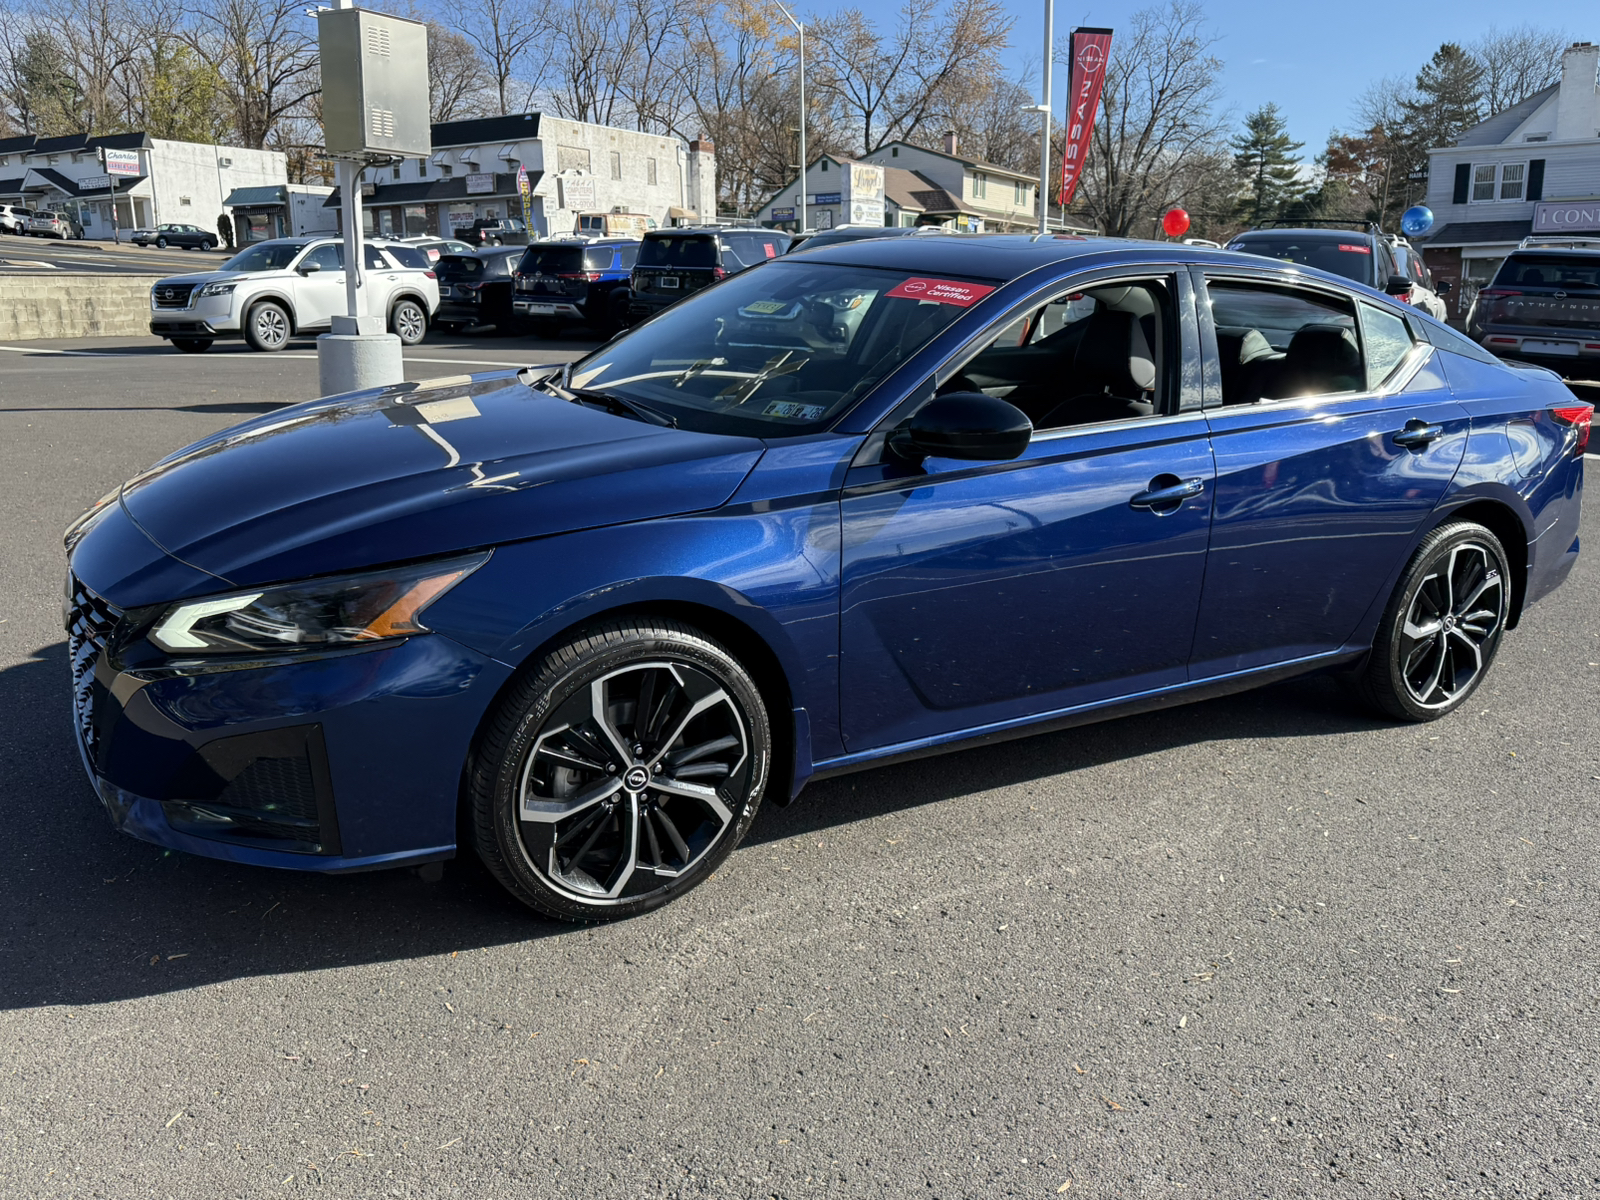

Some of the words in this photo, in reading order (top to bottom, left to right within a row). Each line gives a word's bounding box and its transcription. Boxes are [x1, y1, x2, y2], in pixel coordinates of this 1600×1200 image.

[1064, 81, 1092, 190] NISSAN
[934, 284, 970, 294] Nissan
[927, 290, 974, 301] Certified
